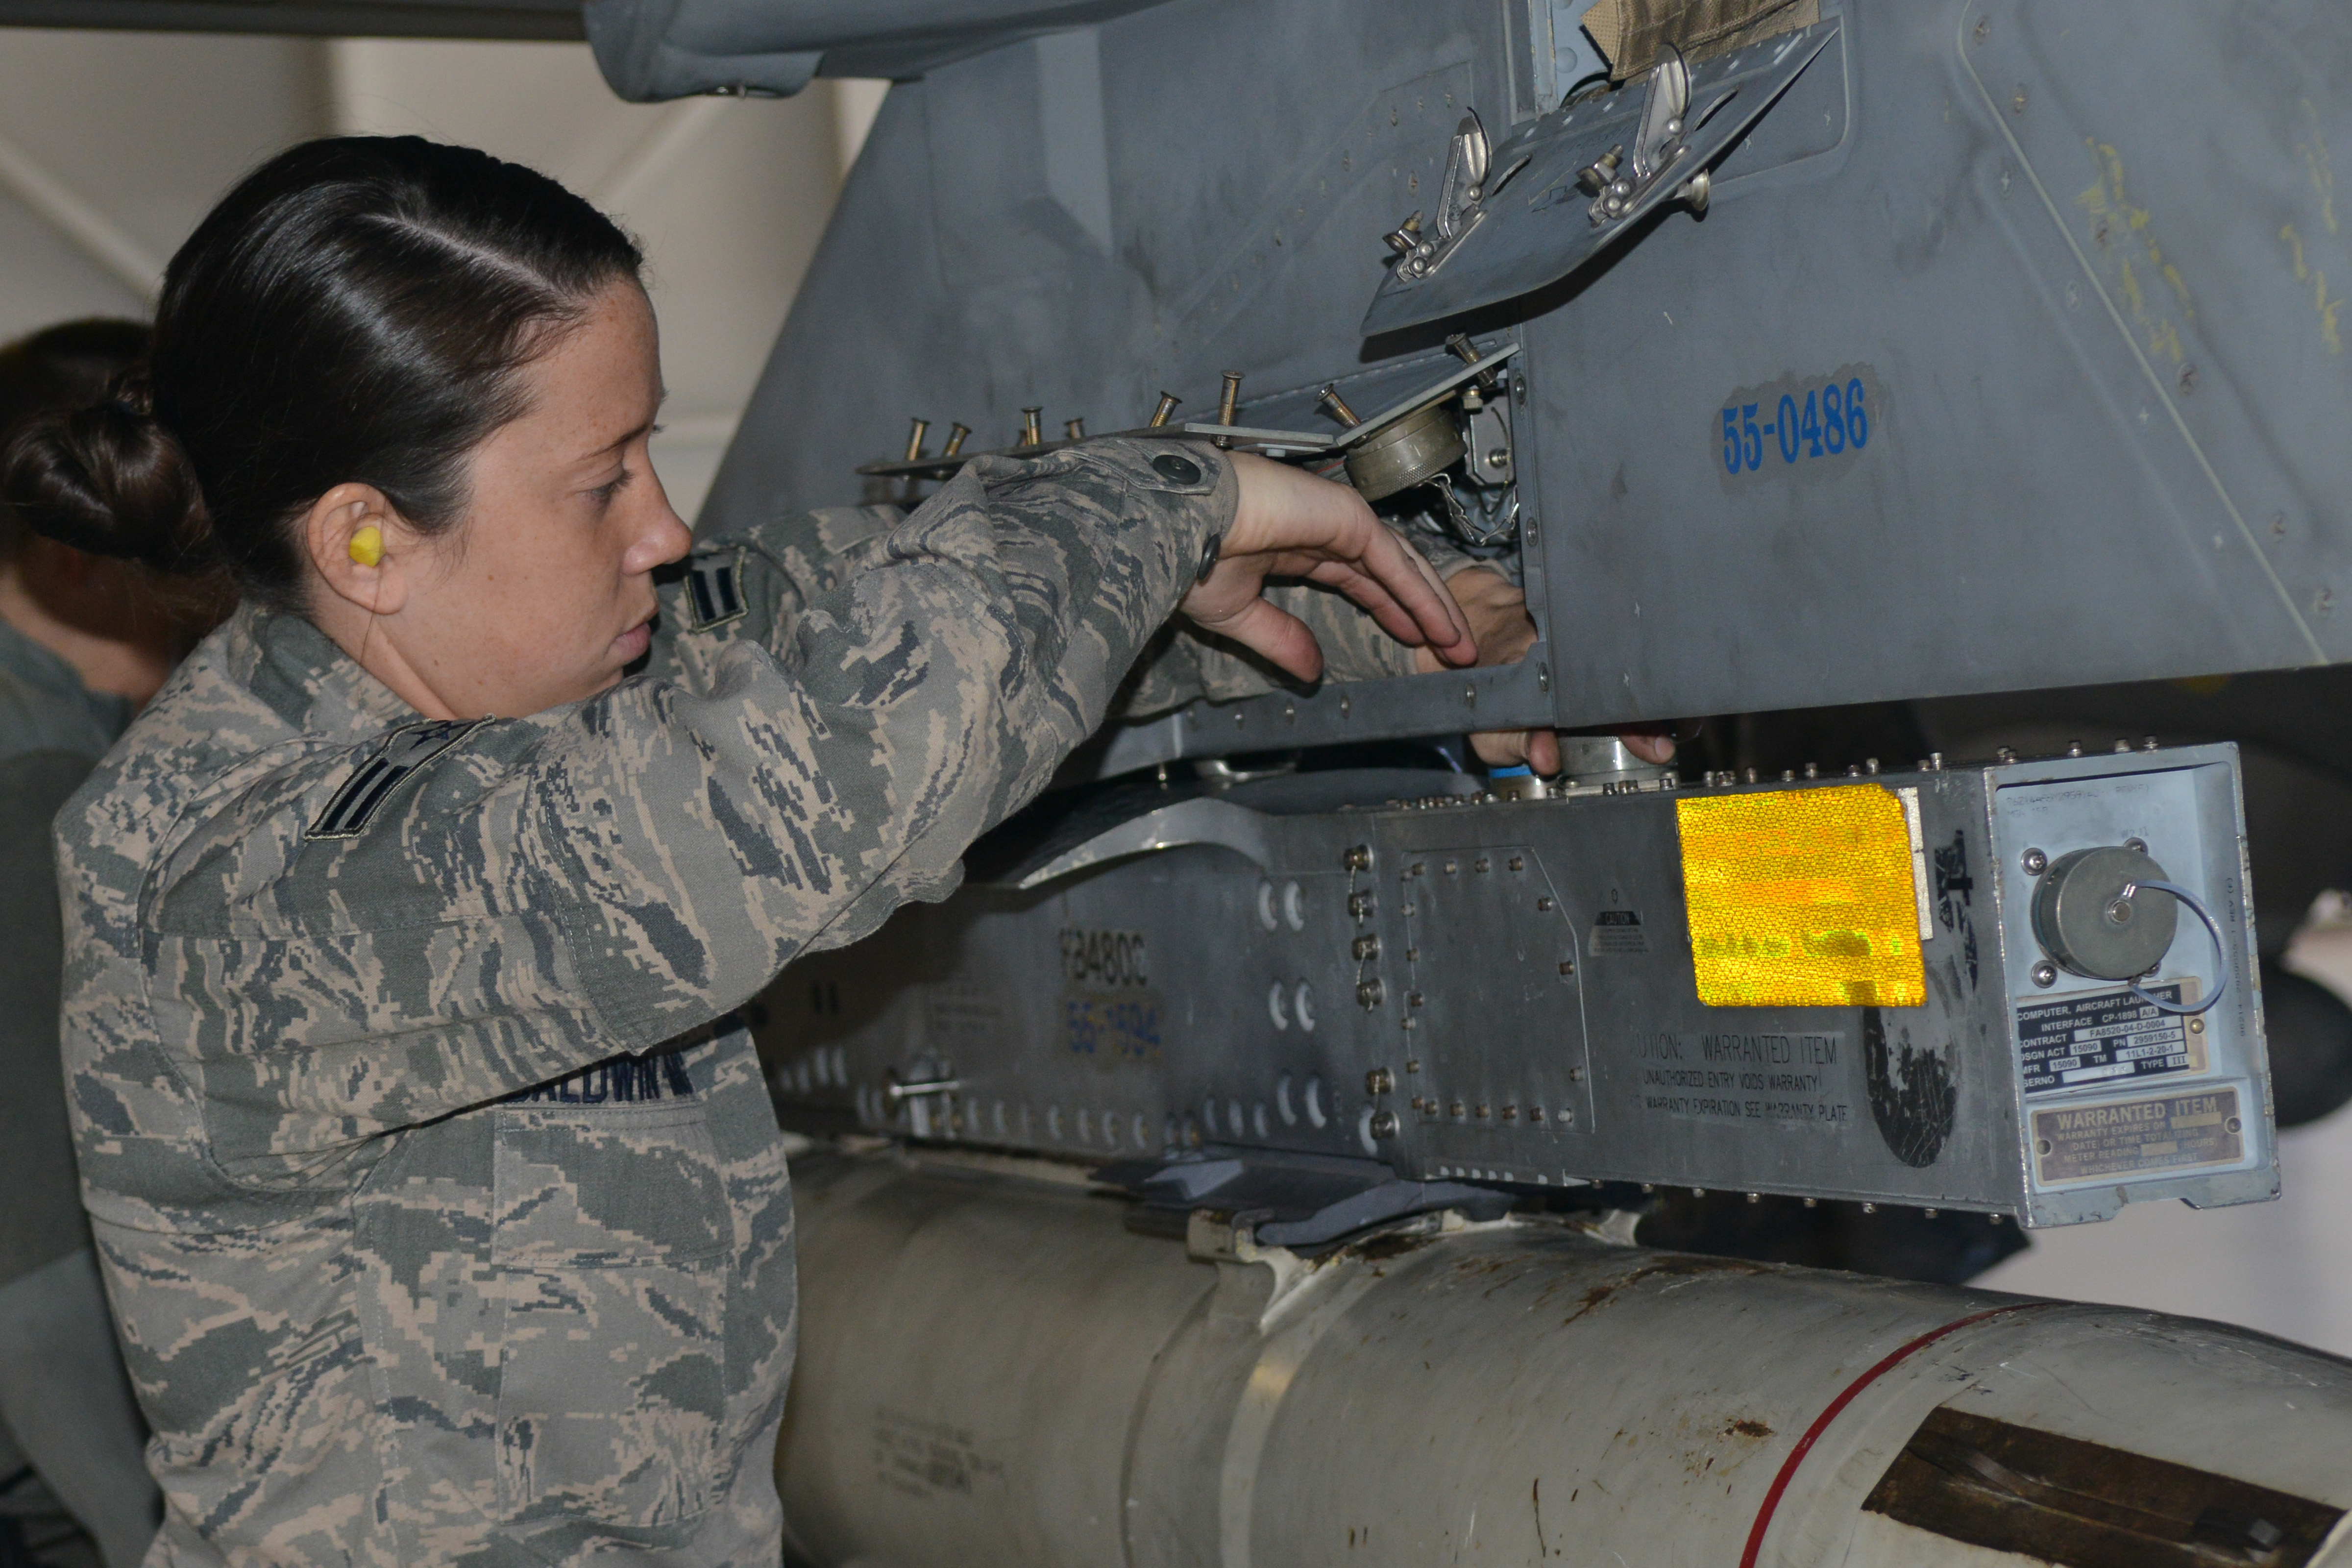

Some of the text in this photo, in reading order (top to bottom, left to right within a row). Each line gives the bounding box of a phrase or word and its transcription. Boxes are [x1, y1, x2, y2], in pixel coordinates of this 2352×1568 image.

[1722, 377, 1868, 474] 55-0486
[2017, 991, 2172, 1021] COMPUTER, AIRCRAFT LAUHER
[2041, 1007, 2156, 1032] INTERFACE CP-1898 A/A
[1701, 1034, 1790, 1063] WARRANTED
[1800, 1036, 1837, 1064] ITEM
[2047, 1047, 2065, 1057] ACT
[2073, 1043, 2098, 1054] 15090
[2113, 1037, 2126, 1048] PN
[2133, 1030, 2176, 1045] 2959150-5
[2024, 1075, 2055, 1087] SERNO
[2141, 1058, 2164, 1070] TYPE
[2053, 1058, 2077, 1069] 15090
[2093, 1054, 2107, 1064] TM
[1643, 1069, 1818, 1092] UNAUTHORIZED ENTRY VOIDS WARRANTY
[1744, 1102, 1762, 1118] SEE
[1818, 1104, 1848, 1122] PLATE
[2057, 1096, 2217, 1130] WARRANTED ITEM
[2057, 1121, 2166, 1142] WARRANTY EXPIRES ON
[2103, 1138, 2116, 1148] OR
[2119, 1135, 2142, 1145] TIME
[2063, 1152, 2096, 1163] METER
[2099, 1147, 2139, 1159] READING
